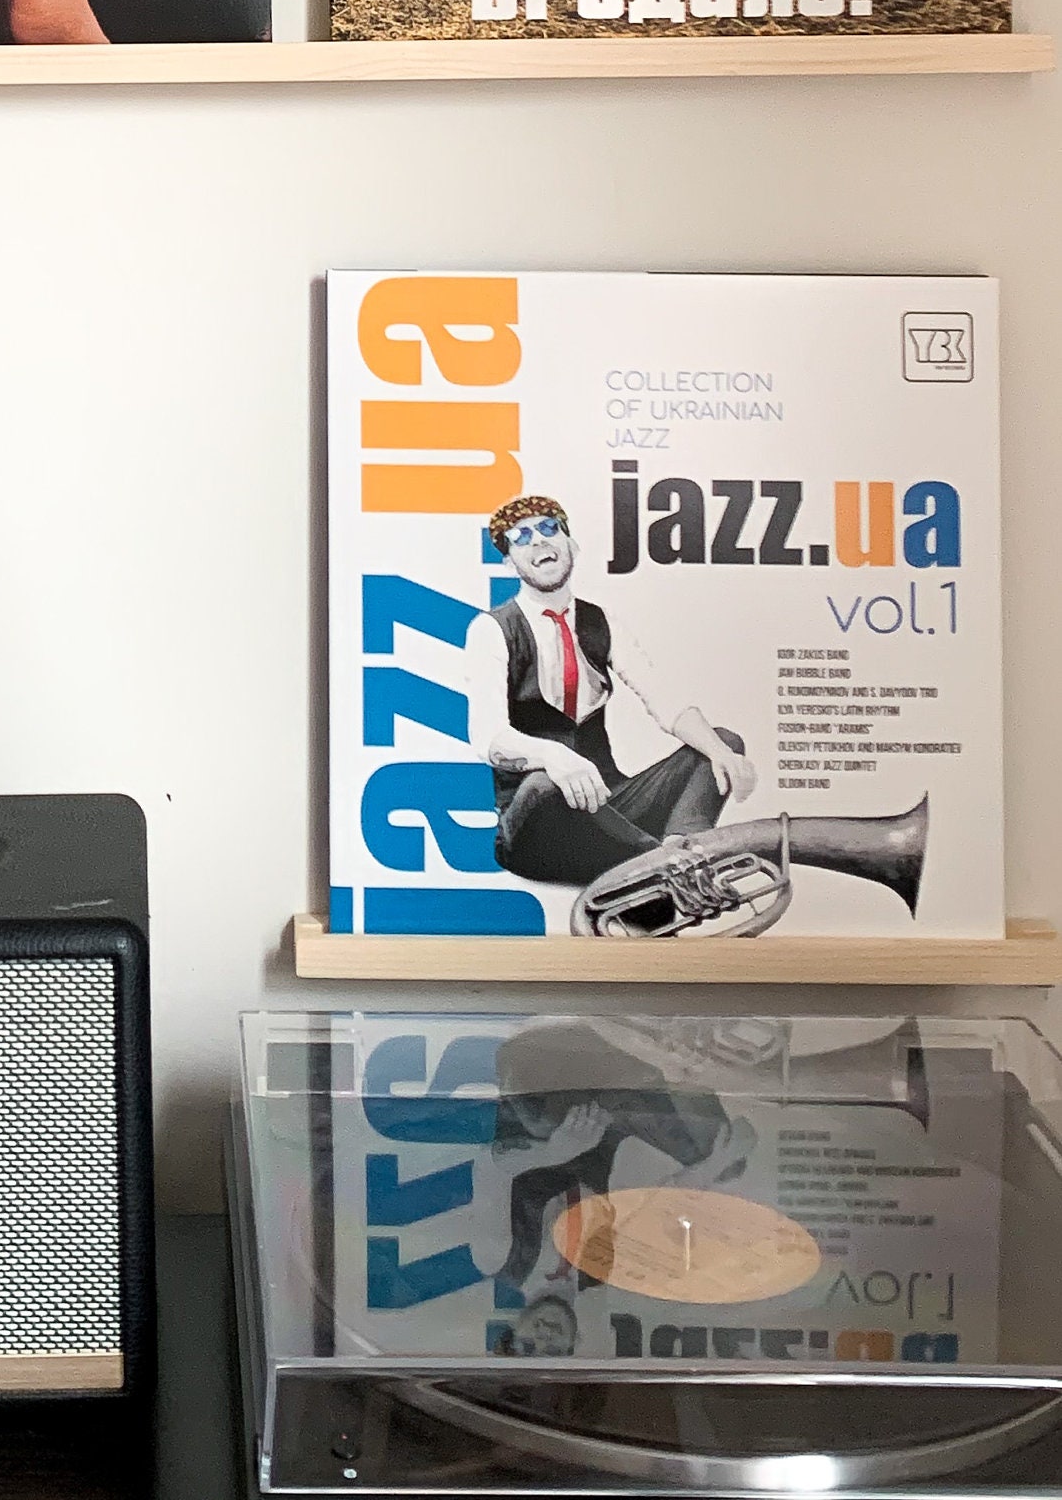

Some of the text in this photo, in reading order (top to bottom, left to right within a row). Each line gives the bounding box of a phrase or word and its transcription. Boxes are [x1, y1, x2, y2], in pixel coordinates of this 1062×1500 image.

[605, 370, 774, 393] COLLECTION
[605, 398, 784, 422] OF UKRAINIAN
[606, 428, 671, 449] JAZZ
[607, 459, 962, 575] jazz.ua
[826, 580, 958, 636] vol.1
